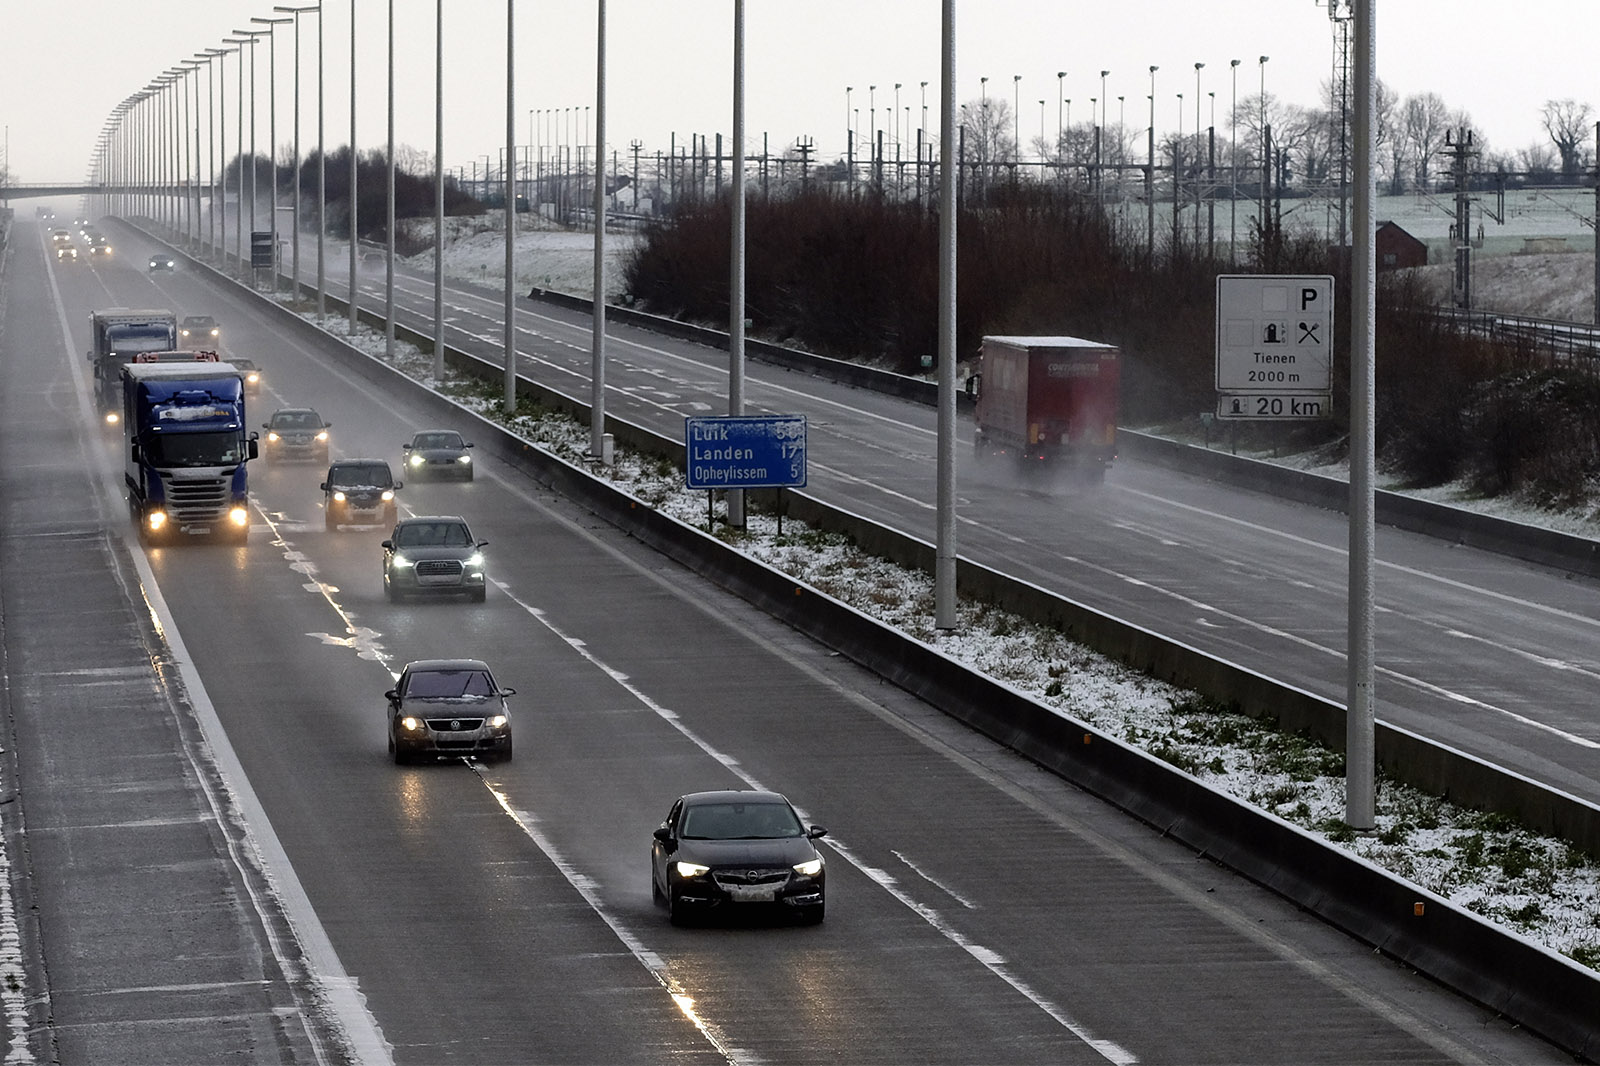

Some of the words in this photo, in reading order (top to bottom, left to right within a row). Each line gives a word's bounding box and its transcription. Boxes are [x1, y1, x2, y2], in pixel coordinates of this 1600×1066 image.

[1301, 288, 1318, 311] P
[1253, 352, 1296, 364] Tienen
[1248, 370, 1285, 382] 2000
[1288, 373, 1300, 382] m
[1256, 397, 1283, 415] 20
[1291, 398, 1320, 415] km
[694, 425, 729, 441] Luik
[694, 446, 753, 460] Landen
[781, 445, 798, 459] 17
[694, 465, 767, 483] Opheylissem
[790, 465, 798, 479] 5
